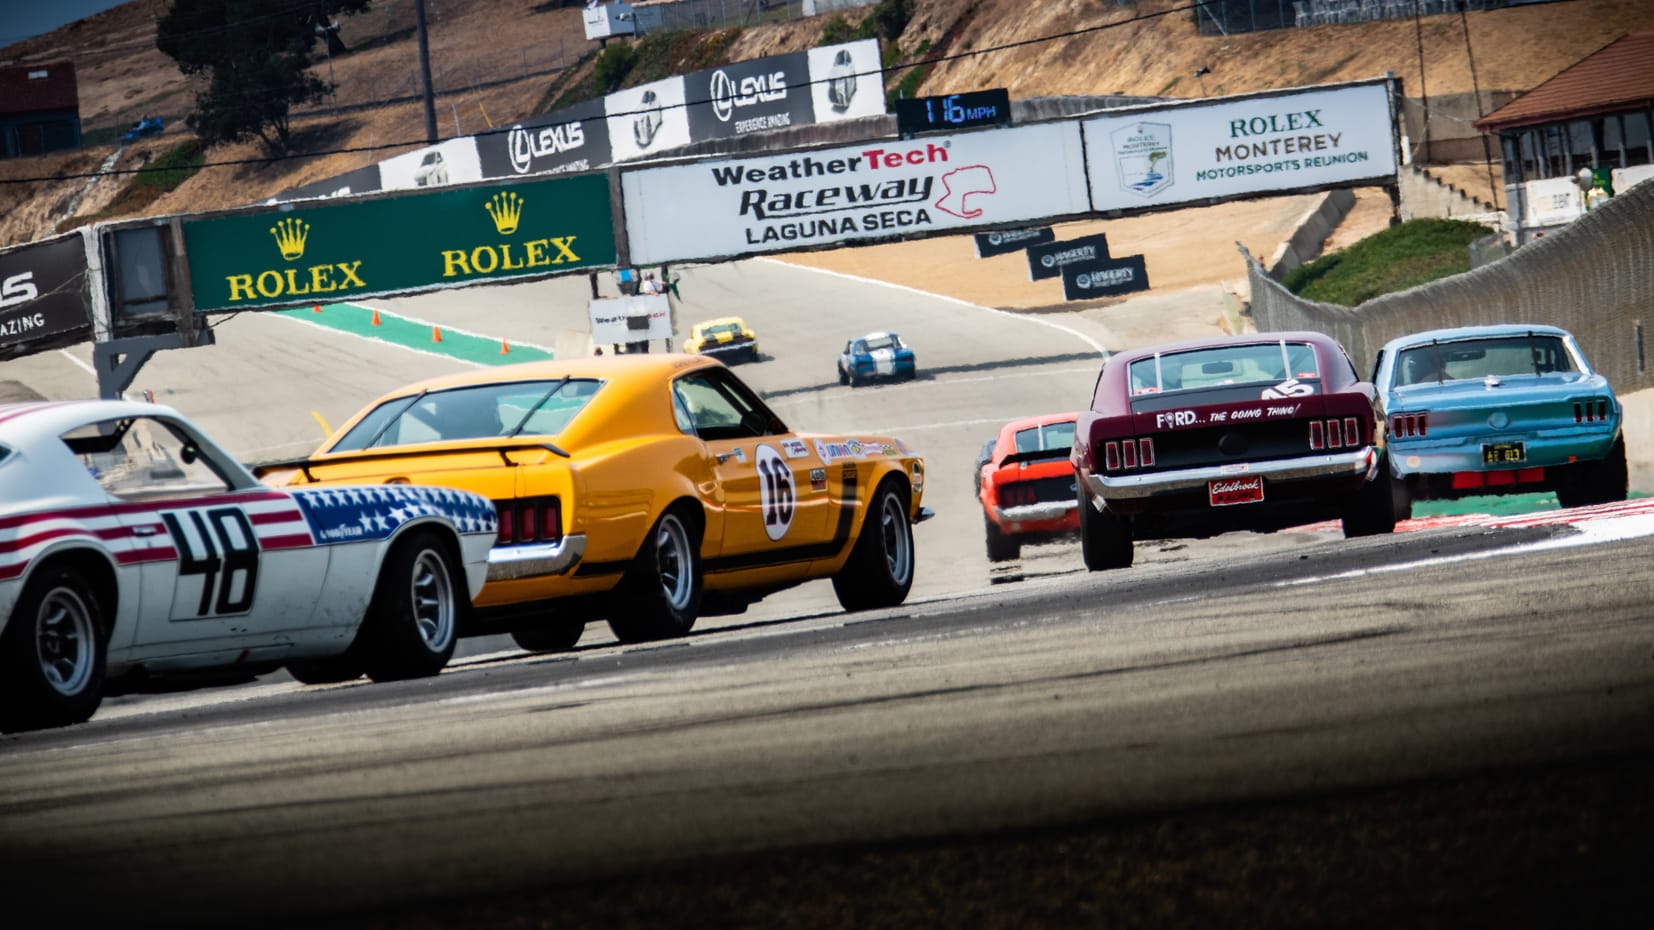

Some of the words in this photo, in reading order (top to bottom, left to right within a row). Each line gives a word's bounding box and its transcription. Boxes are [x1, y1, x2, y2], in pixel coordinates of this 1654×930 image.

[731, 71, 787, 107] LEXUS
[926, 95, 966, 123] 116
[967, 106, 996, 120] MPH
[1229, 109, 1324, 138] ROLEX
[531, 121, 585, 158] LEXUS
[1215, 132, 1342, 162] MONTEREY
[712, 144, 949, 187] WeatherTech
[1196, 159, 1301, 182] MOTORSPORTS
[1303, 151, 1369, 169] REUNION
[739, 176, 934, 221] Raceway
[745, 217, 859, 245] LAGUNA
[862, 208, 932, 231] SECA
[441, 236, 581, 277] ROLEX
[226, 260, 366, 300] ROLEX
[0, 312, 45, 336] AZING
[1209, 412, 1228, 422] THE
[1231, 408, 1262, 420] GOING
[758, 457, 793, 526] 16
[1212, 479, 1259, 494] Edelbrock
[162, 507, 260, 616] 48
